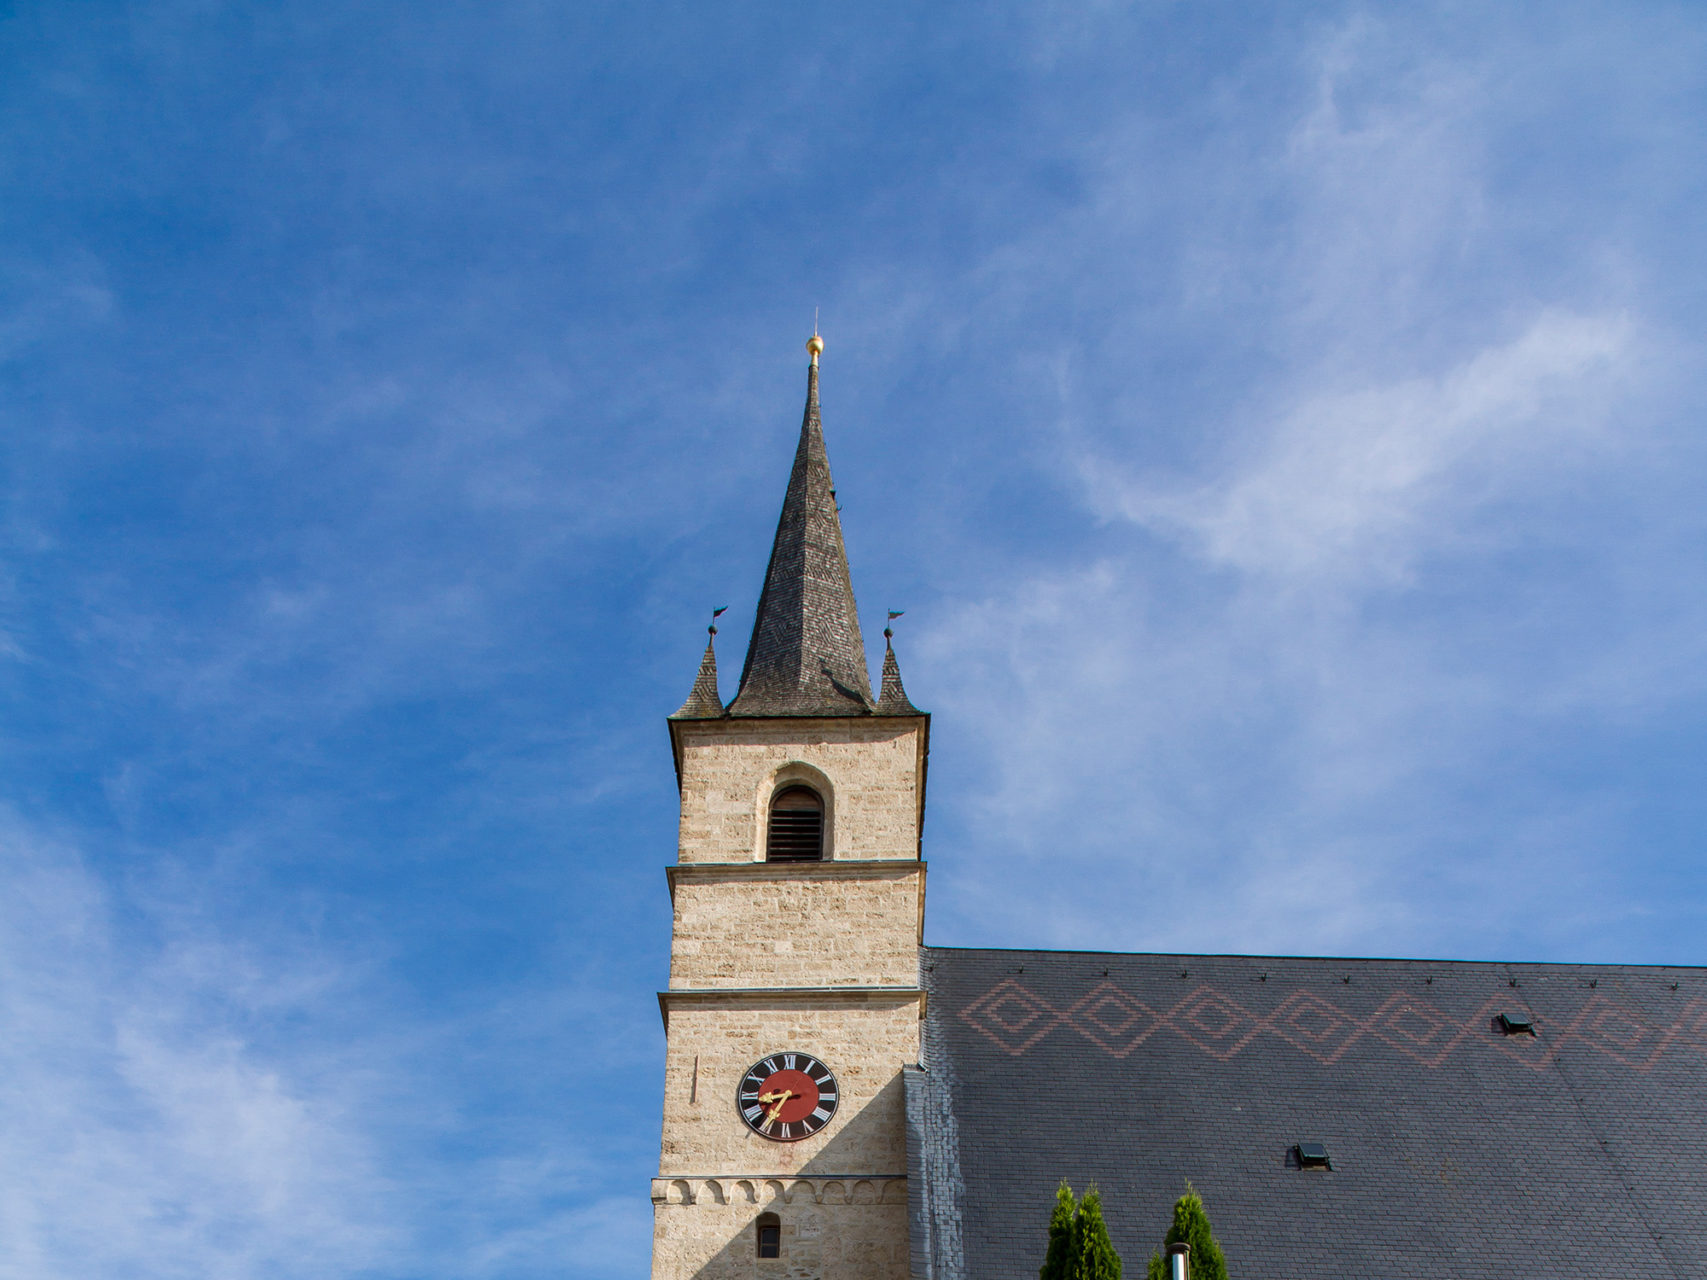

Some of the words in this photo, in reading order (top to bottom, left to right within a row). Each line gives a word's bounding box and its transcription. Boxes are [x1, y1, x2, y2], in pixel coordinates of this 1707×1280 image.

[763, 1058, 780, 1075] XI
[783, 1054, 797, 1071] XII
[803, 1059, 816, 1075] I
[747, 1071, 766, 1087] X
[741, 1090, 760, 1101] IX
[744, 1103, 763, 1123] VIII
[781, 1122, 792, 1138] VI
[802, 1120, 815, 1135] V
